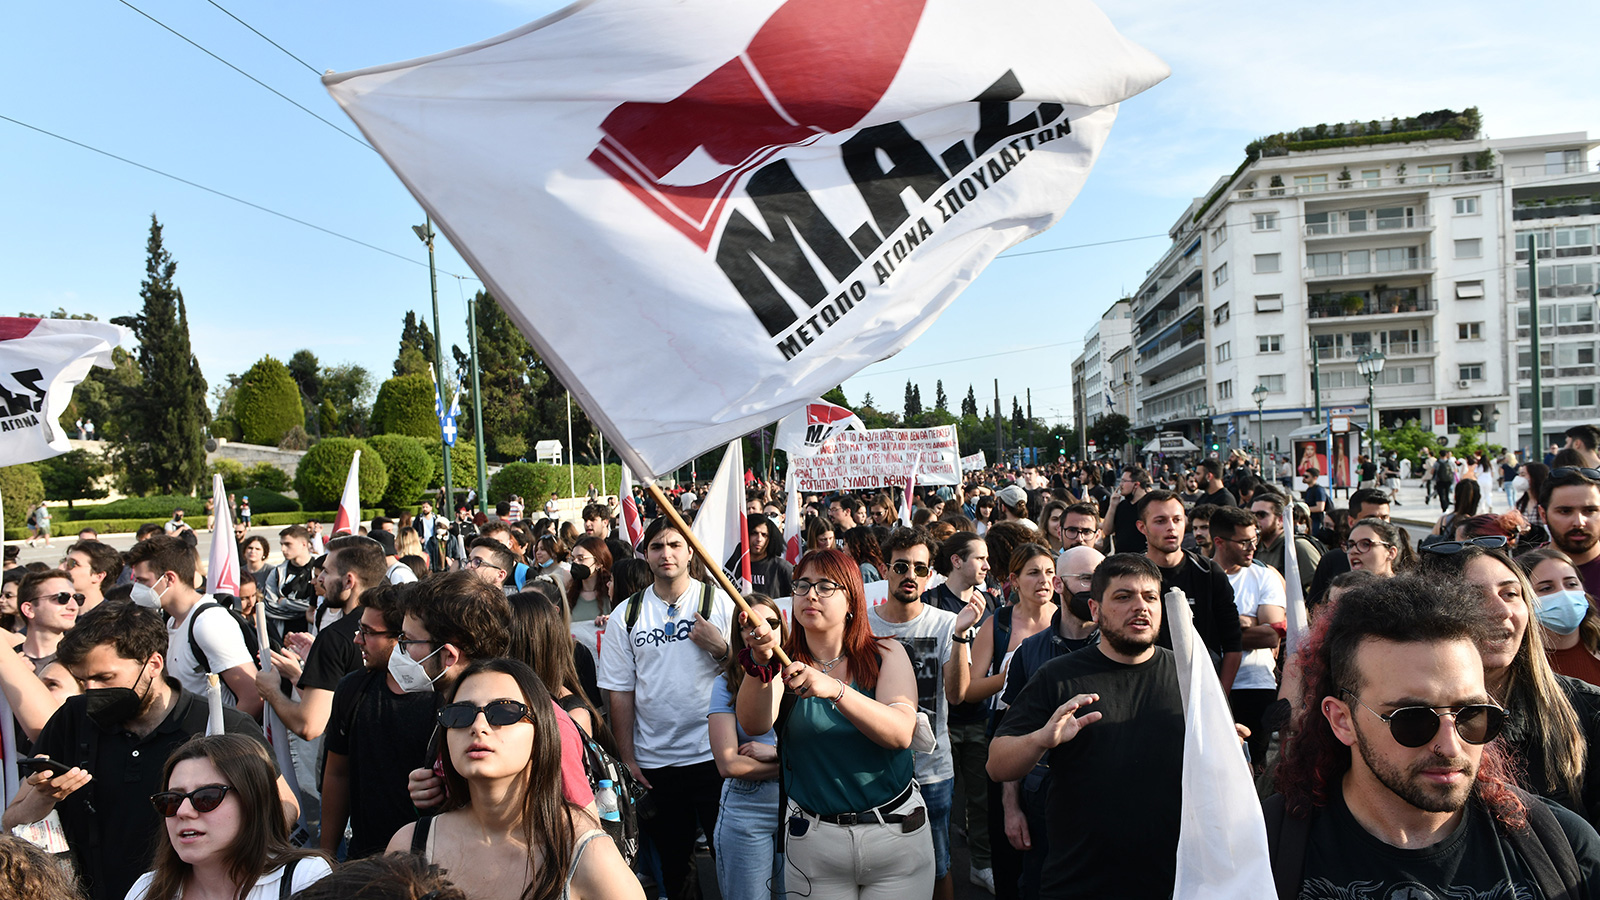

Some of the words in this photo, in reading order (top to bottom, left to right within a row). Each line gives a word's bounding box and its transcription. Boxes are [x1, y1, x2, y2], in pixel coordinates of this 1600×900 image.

[776, 280, 866, 362] ΜΕΤΩΠΟ
[872, 217, 934, 286] ΑΓΩΝΑ
[934, 117, 1073, 224] ΣΠΟΥΔΑΣΤΩΝ
[1, 414, 40, 432] ΑΓΩΝΑ
[800, 478, 839, 491] ΦΟΙΤΗΤΙΚΟΙ
[842, 475, 879, 488] ΣΥΛΛΟΓΟΙ
[883, 473, 921, 486] ΑΘΗΝΣ
